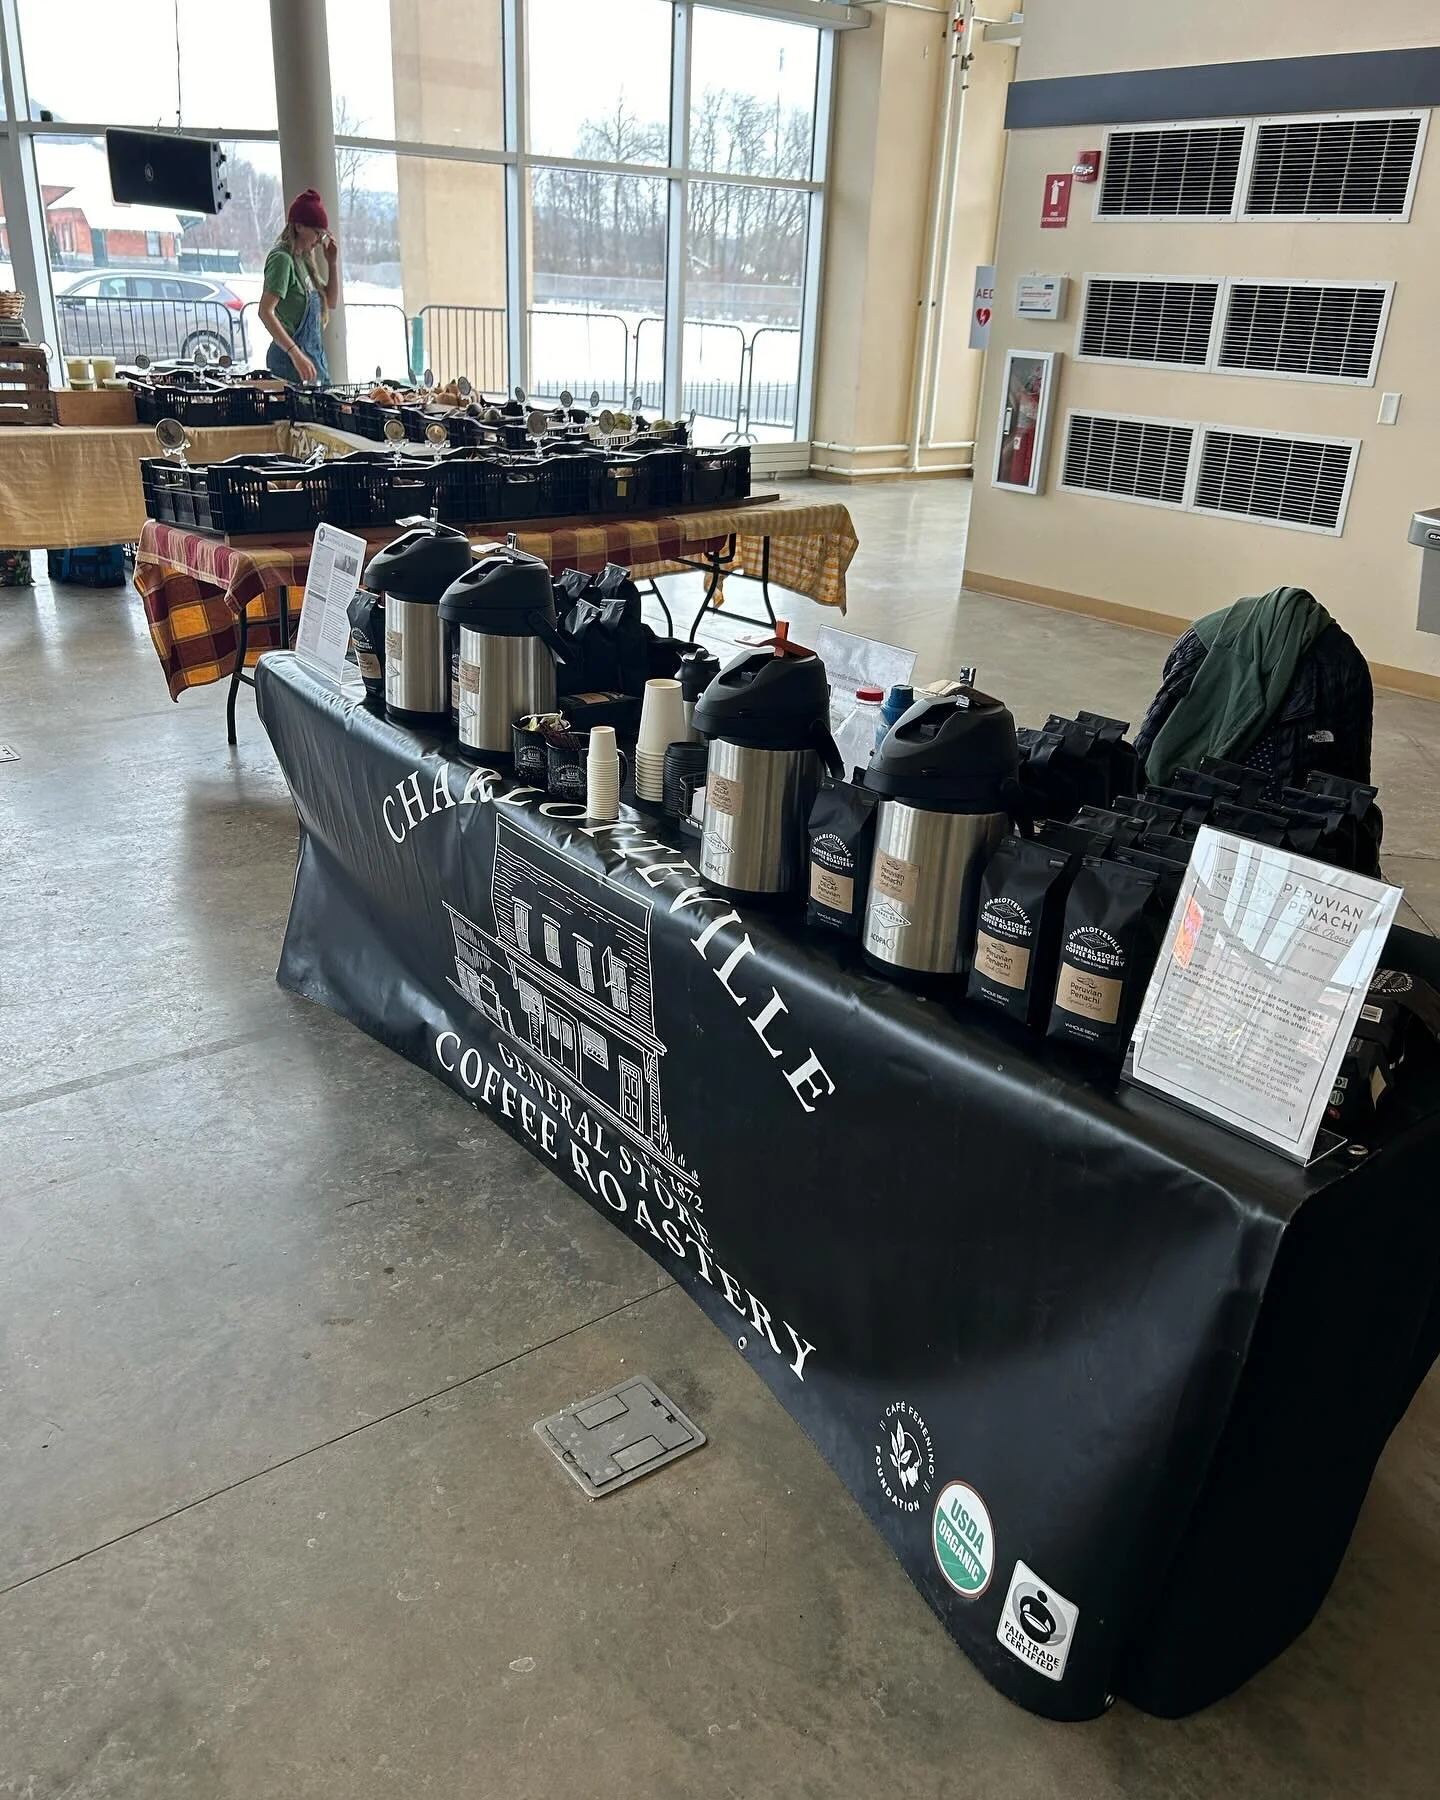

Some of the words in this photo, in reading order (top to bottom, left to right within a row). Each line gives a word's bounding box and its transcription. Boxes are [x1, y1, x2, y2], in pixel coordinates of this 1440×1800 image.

[820, 880, 839, 891] DECAF
[1282, 882, 1364, 920] PERUVIAN
[980, 913, 998, 928] COFFEE
[998, 922, 1033, 937] ROASTERY
[984, 897, 1031, 925] CHARLOTTEVILLE
[984, 911, 1006, 925] GENERAL
[1007, 920, 1027, 931] STORE
[1287, 900, 1358, 934] PENACHI
[381, 764, 837, 1114] CHARLOTTEVILLE
[986, 946, 1013, 964] Peruvian
[1065, 944, 1086, 958] COFFEE
[1087, 952, 1125, 967] ROASTERY
[1068, 926, 1124, 955] CHARLOTTEVILLE
[1069, 941, 1095, 956] GENERAL
[1096, 950, 1119, 961] STORE
[986, 954, 1011, 970] Penachi
[1070, 981, 1103, 998] Peruvian
[1070, 989, 1100, 1005] Penachi
[498, 1042, 611, 1158] GENERAL
[619, 1145, 714, 1253] STORE
[435, 1031, 559, 1160] COFFEE
[569, 1138, 817, 1382] ROASTERY
[669, 1175, 704, 1213] 1872
[885, 1401, 906, 1417] CAFÉ
[908, 1405, 935, 1474] FEMENINO
[875, 1445, 920, 1512] FOUNDATION
[950, 1498, 985, 1555] USDA
[938, 1518, 981, 1583] ORGANIC
[1004, 1621, 1025, 1644] FAIR
[1028, 1640, 1061, 1667] TRADE
[1005, 1633, 1054, 1672] CERTIFIED
